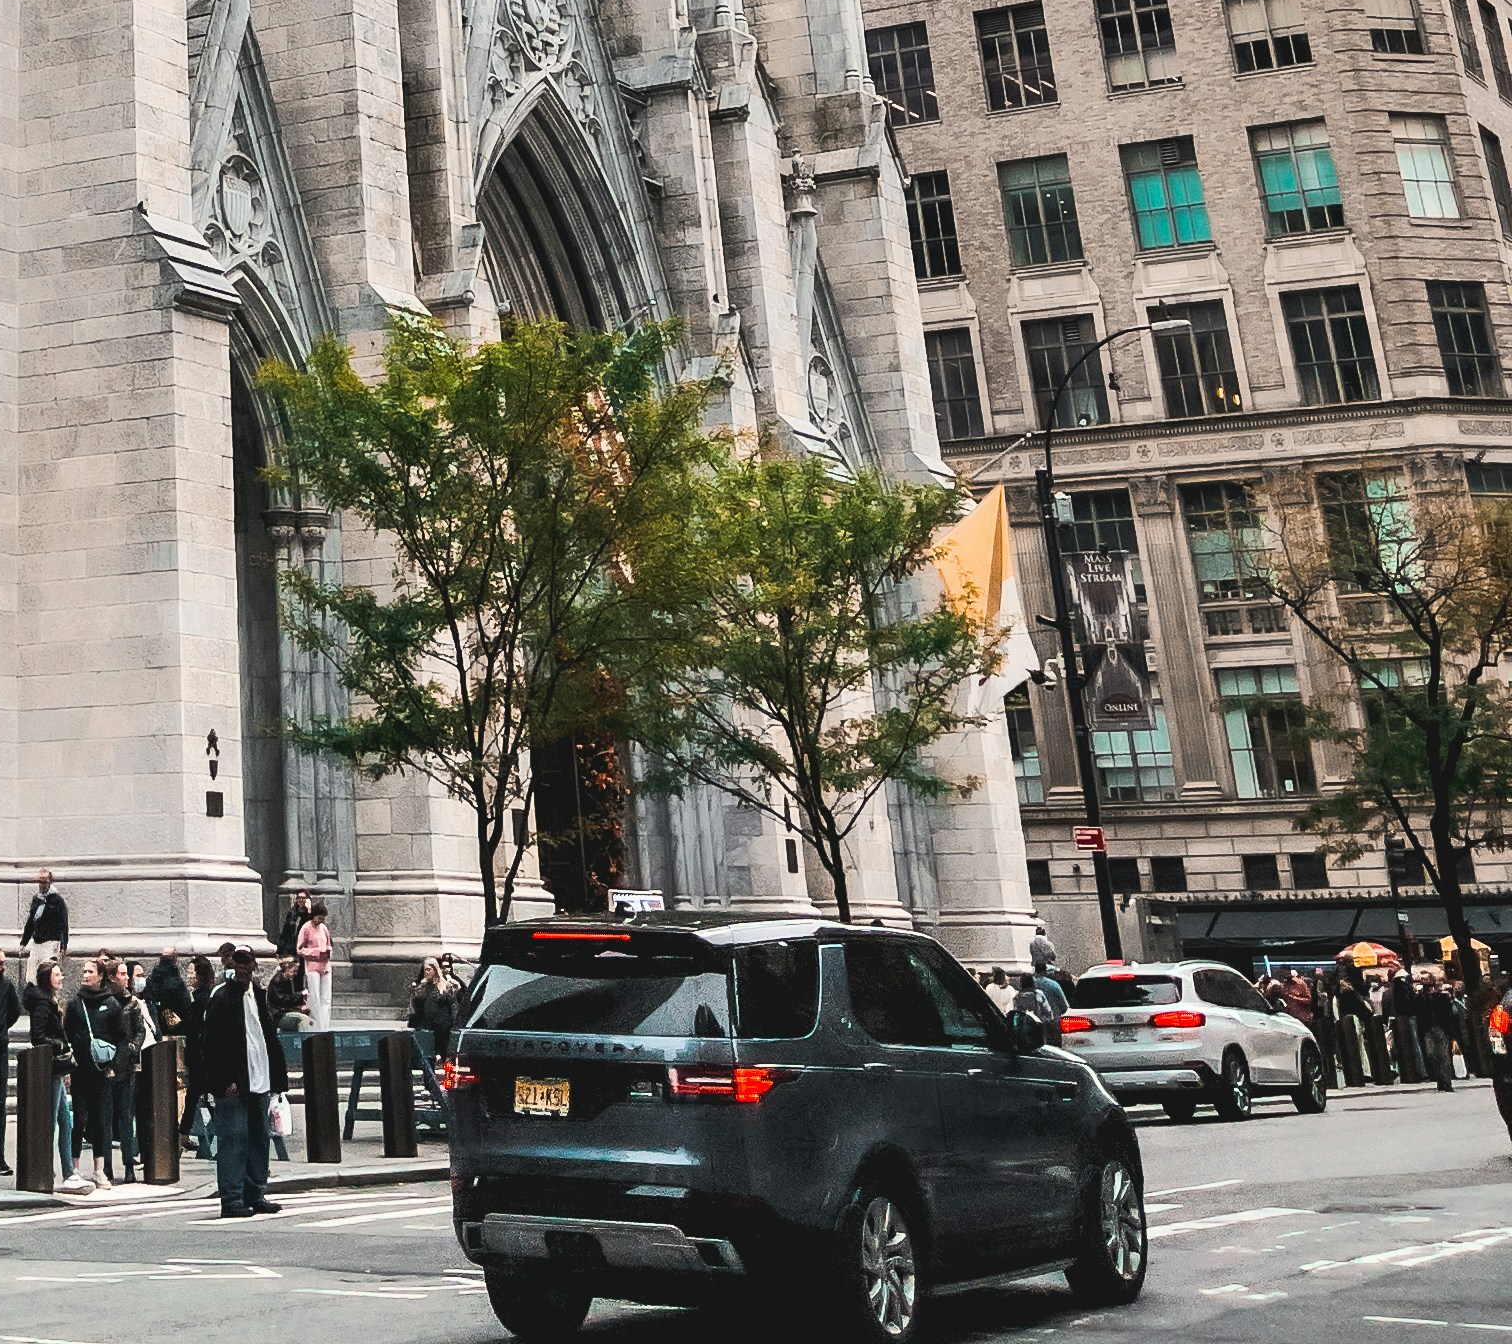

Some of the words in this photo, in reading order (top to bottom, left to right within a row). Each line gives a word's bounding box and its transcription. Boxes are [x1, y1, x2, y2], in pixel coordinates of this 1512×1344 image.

[1084, 554, 1112, 564] MASS
[1088, 563, 1111, 573] LIVE
[1080, 573, 1122, 583] STREAM
[1104, 703, 1138, 712] ONLINE
